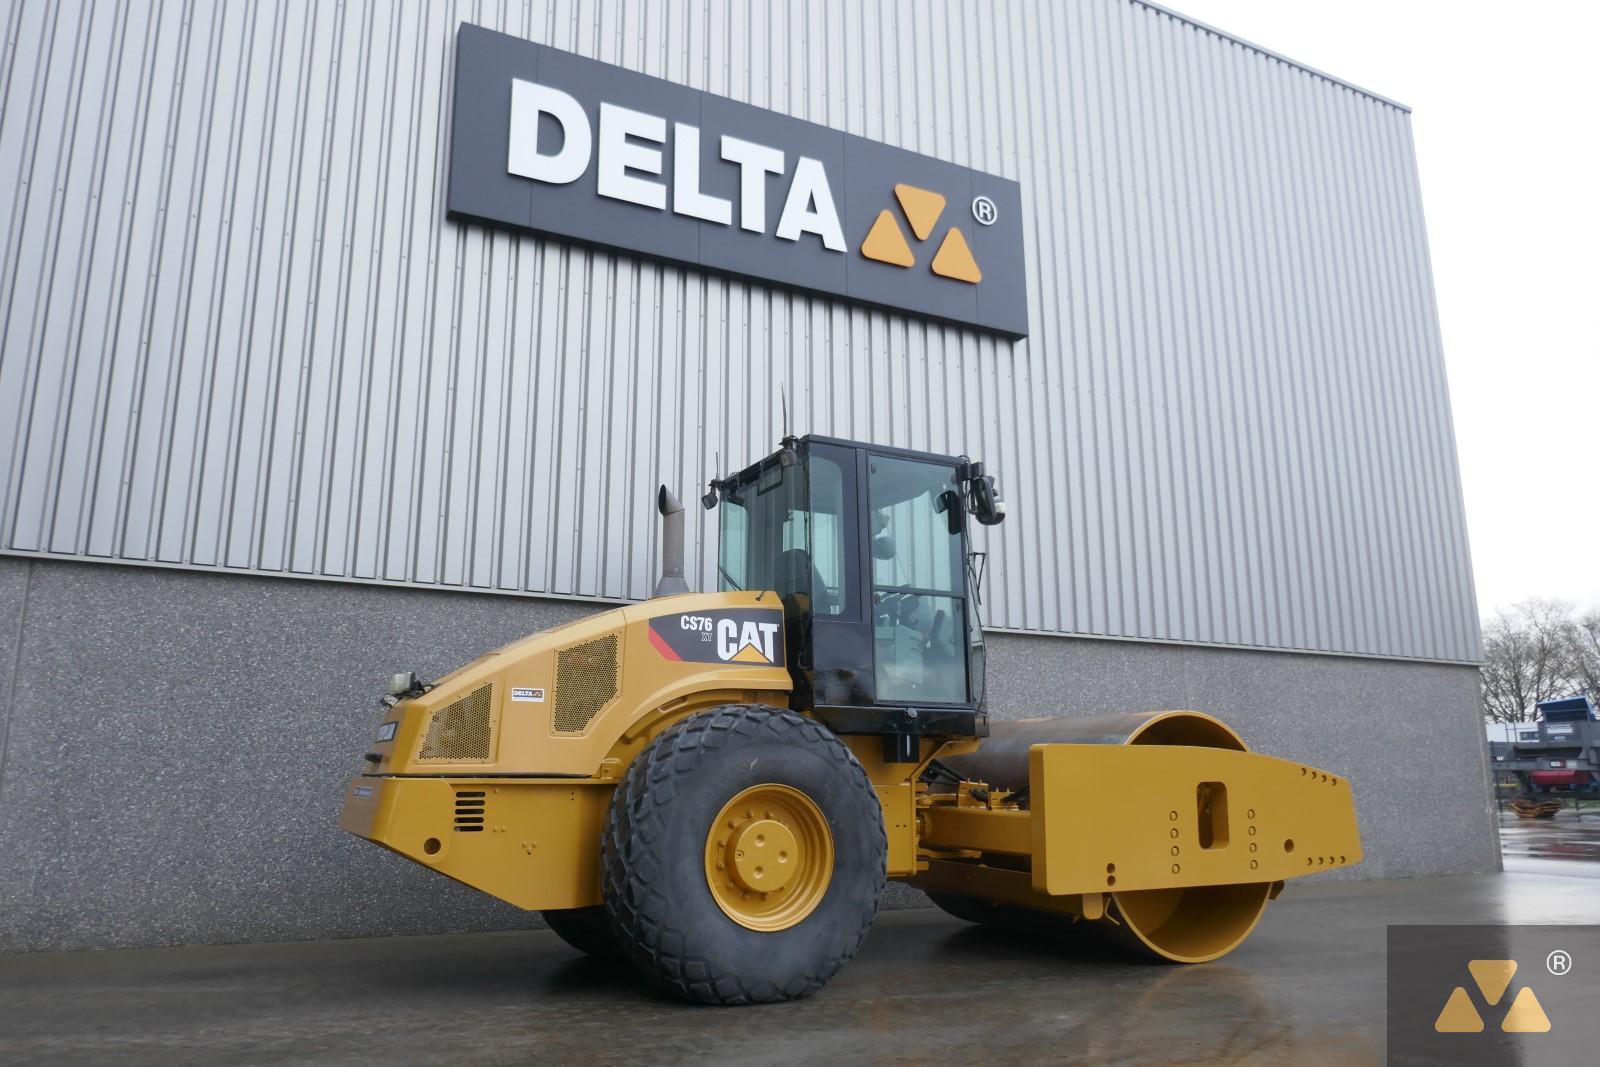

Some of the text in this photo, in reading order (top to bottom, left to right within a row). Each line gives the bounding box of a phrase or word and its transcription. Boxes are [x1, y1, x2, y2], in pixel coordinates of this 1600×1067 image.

[507, 78, 848, 253] DELTA
[680, 614, 713, 632] CS76
[717, 618, 778, 664] CAT
